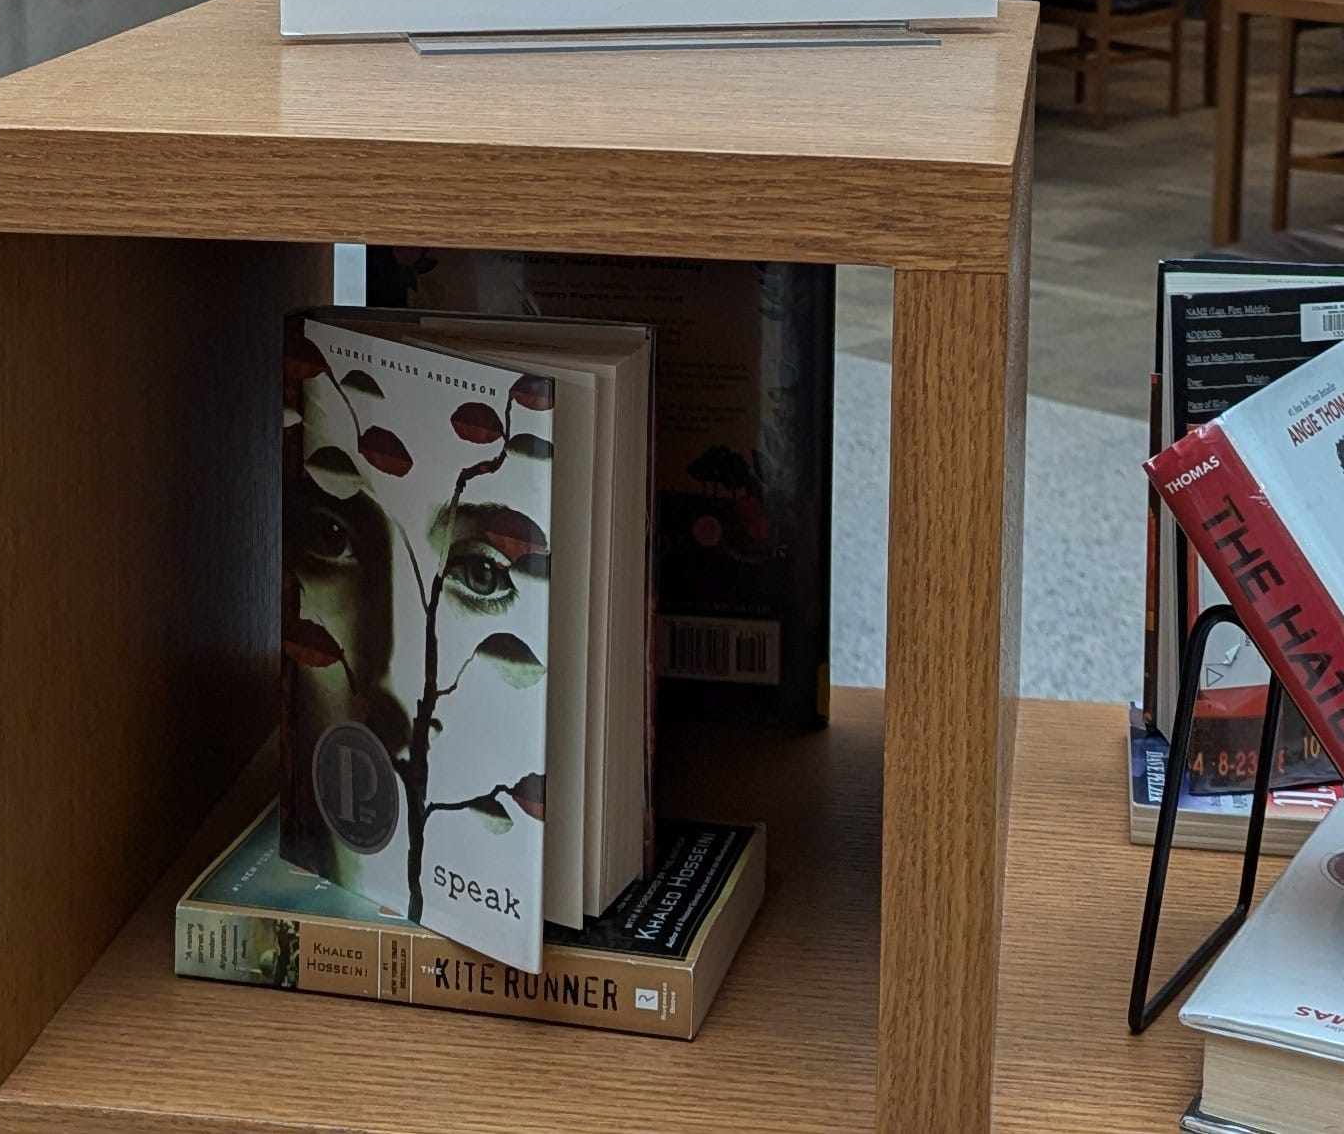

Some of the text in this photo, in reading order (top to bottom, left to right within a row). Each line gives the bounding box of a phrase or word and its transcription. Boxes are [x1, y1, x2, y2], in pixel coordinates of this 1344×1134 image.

[1332, 330, 1344, 338] 133
[329, 344, 497, 397] LAURIE HALSE ANDERSON
[1287, 413, 1323, 447] ANGIE
[1165, 454, 1220, 496] THOMAS
[1202, 494, 1284, 603] THE
[434, 865, 520, 920] speak
[634, 890, 683, 941] KHALED
[667, 832, 718, 888] HOSSEINI
[306, 957, 369, 978] HOSSEINI
[313, 942, 364, 961] KHALED
[421, 956, 619, 1011] THE KITE RUNNER
